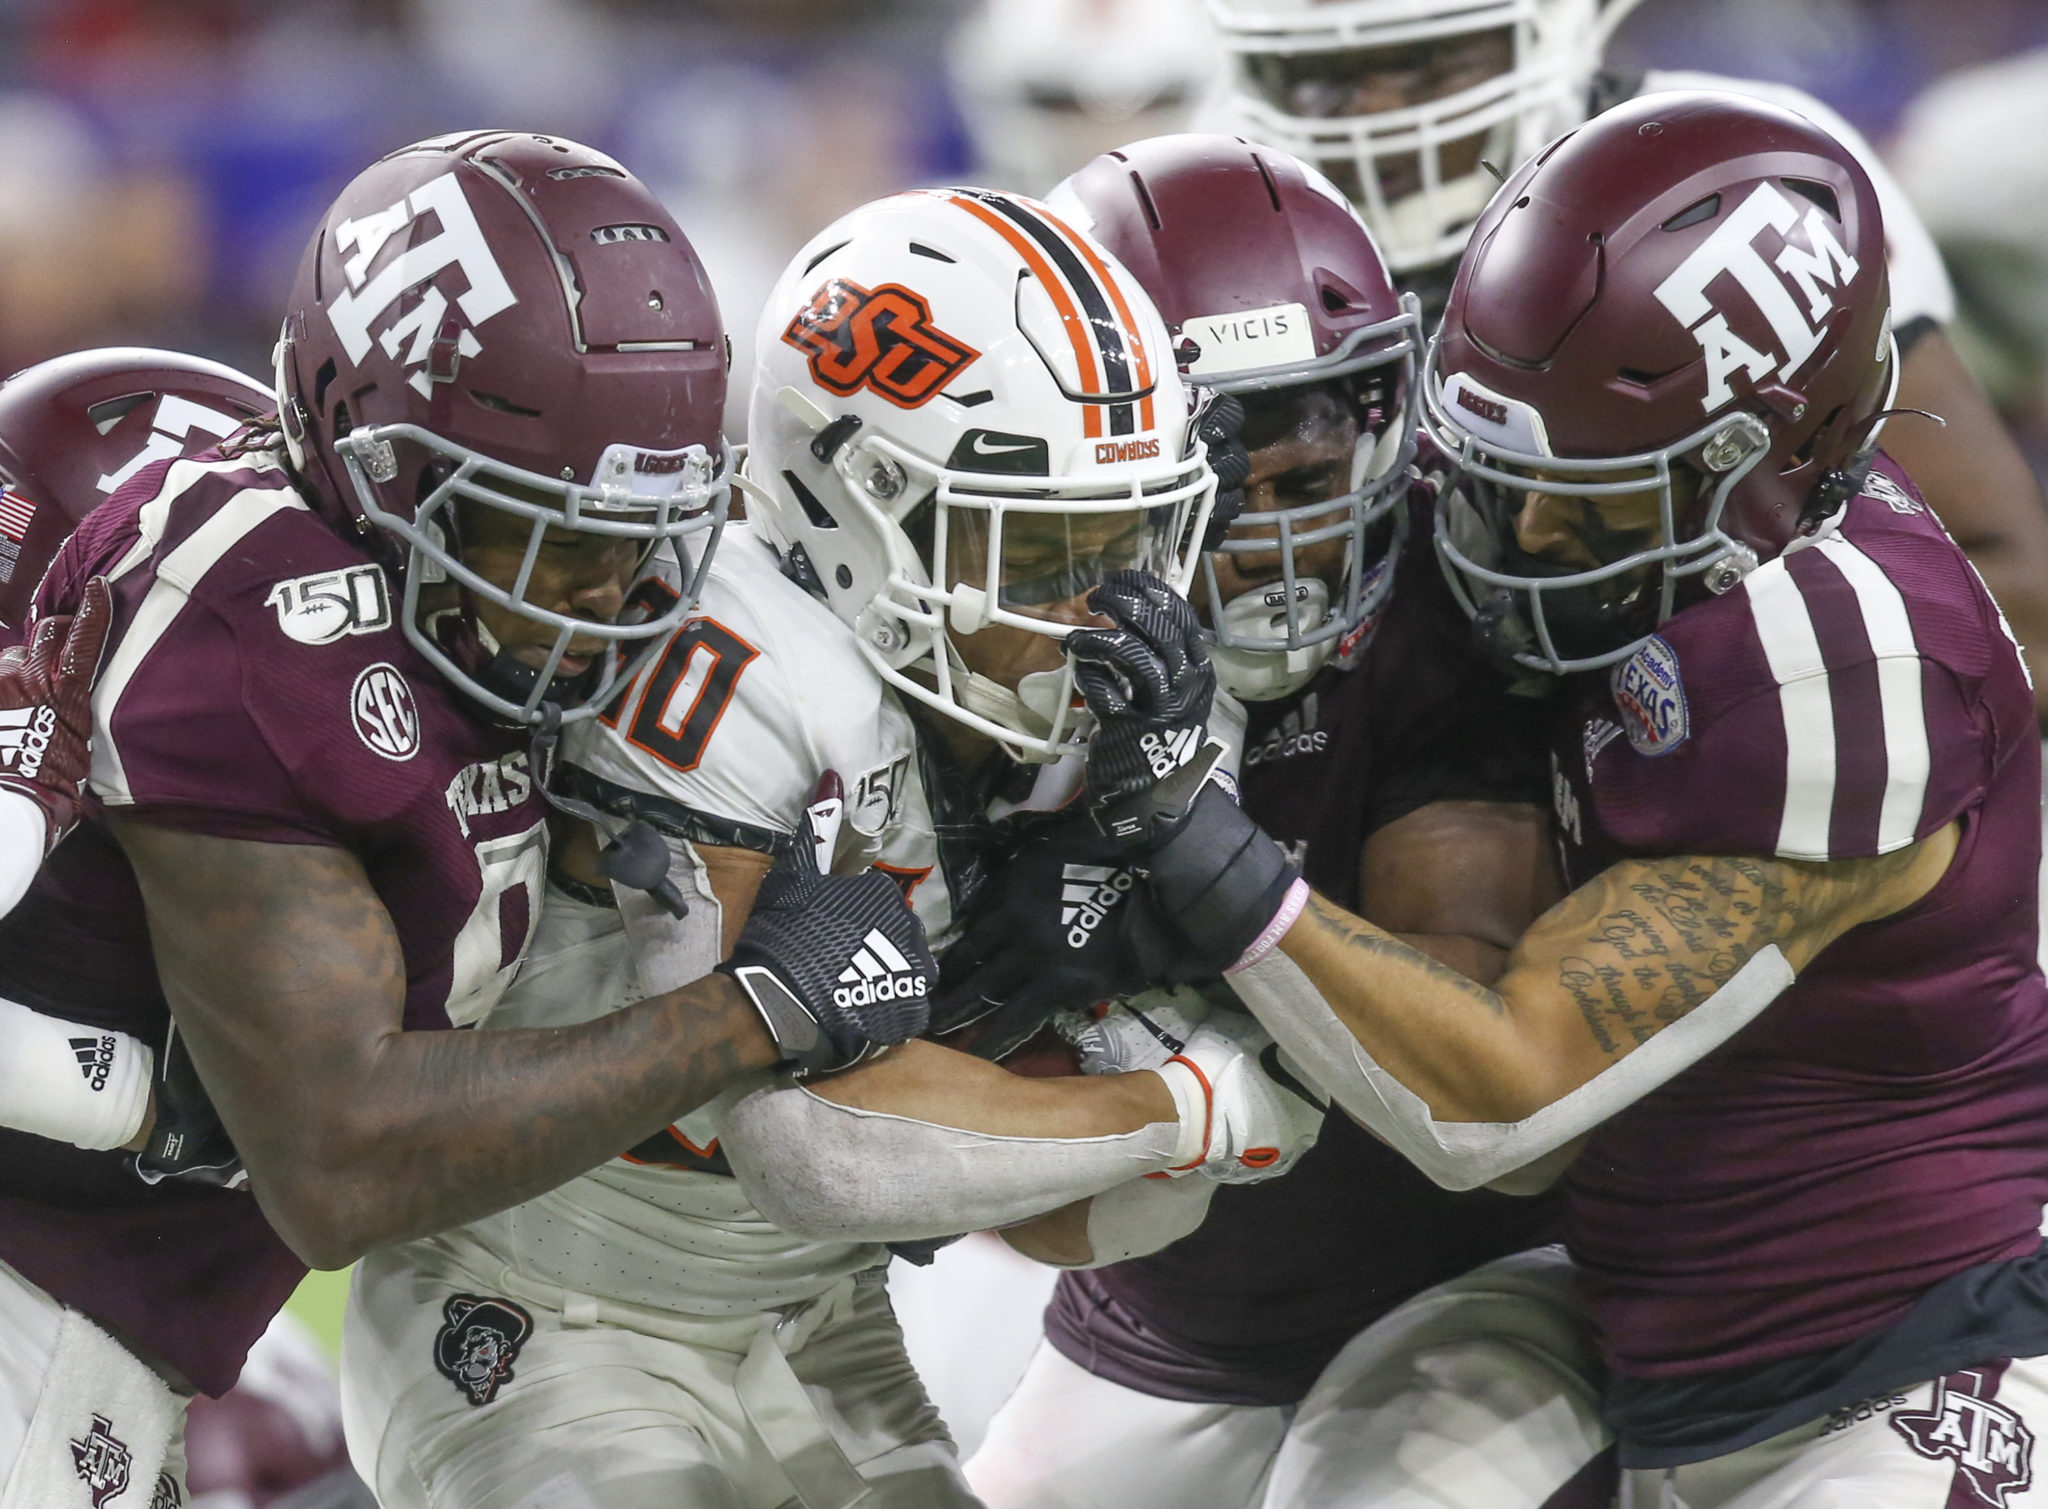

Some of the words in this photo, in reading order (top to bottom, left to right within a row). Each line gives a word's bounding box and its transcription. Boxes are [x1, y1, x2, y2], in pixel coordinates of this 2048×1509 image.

[1209, 315, 1288, 343] VICIS
[1095, 438, 1160, 464] COWBOYS
[277, 566, 390, 641] 150
[1637, 645, 1676, 690] Academy
[357, 671, 416, 753] SEC
[17, 704, 57, 779] adidas
[1139, 732, 1177, 781] adid
[1067, 866, 1150, 948] adida
[833, 973, 927, 1009] adidas
[90, 1036, 117, 1092] adidas
